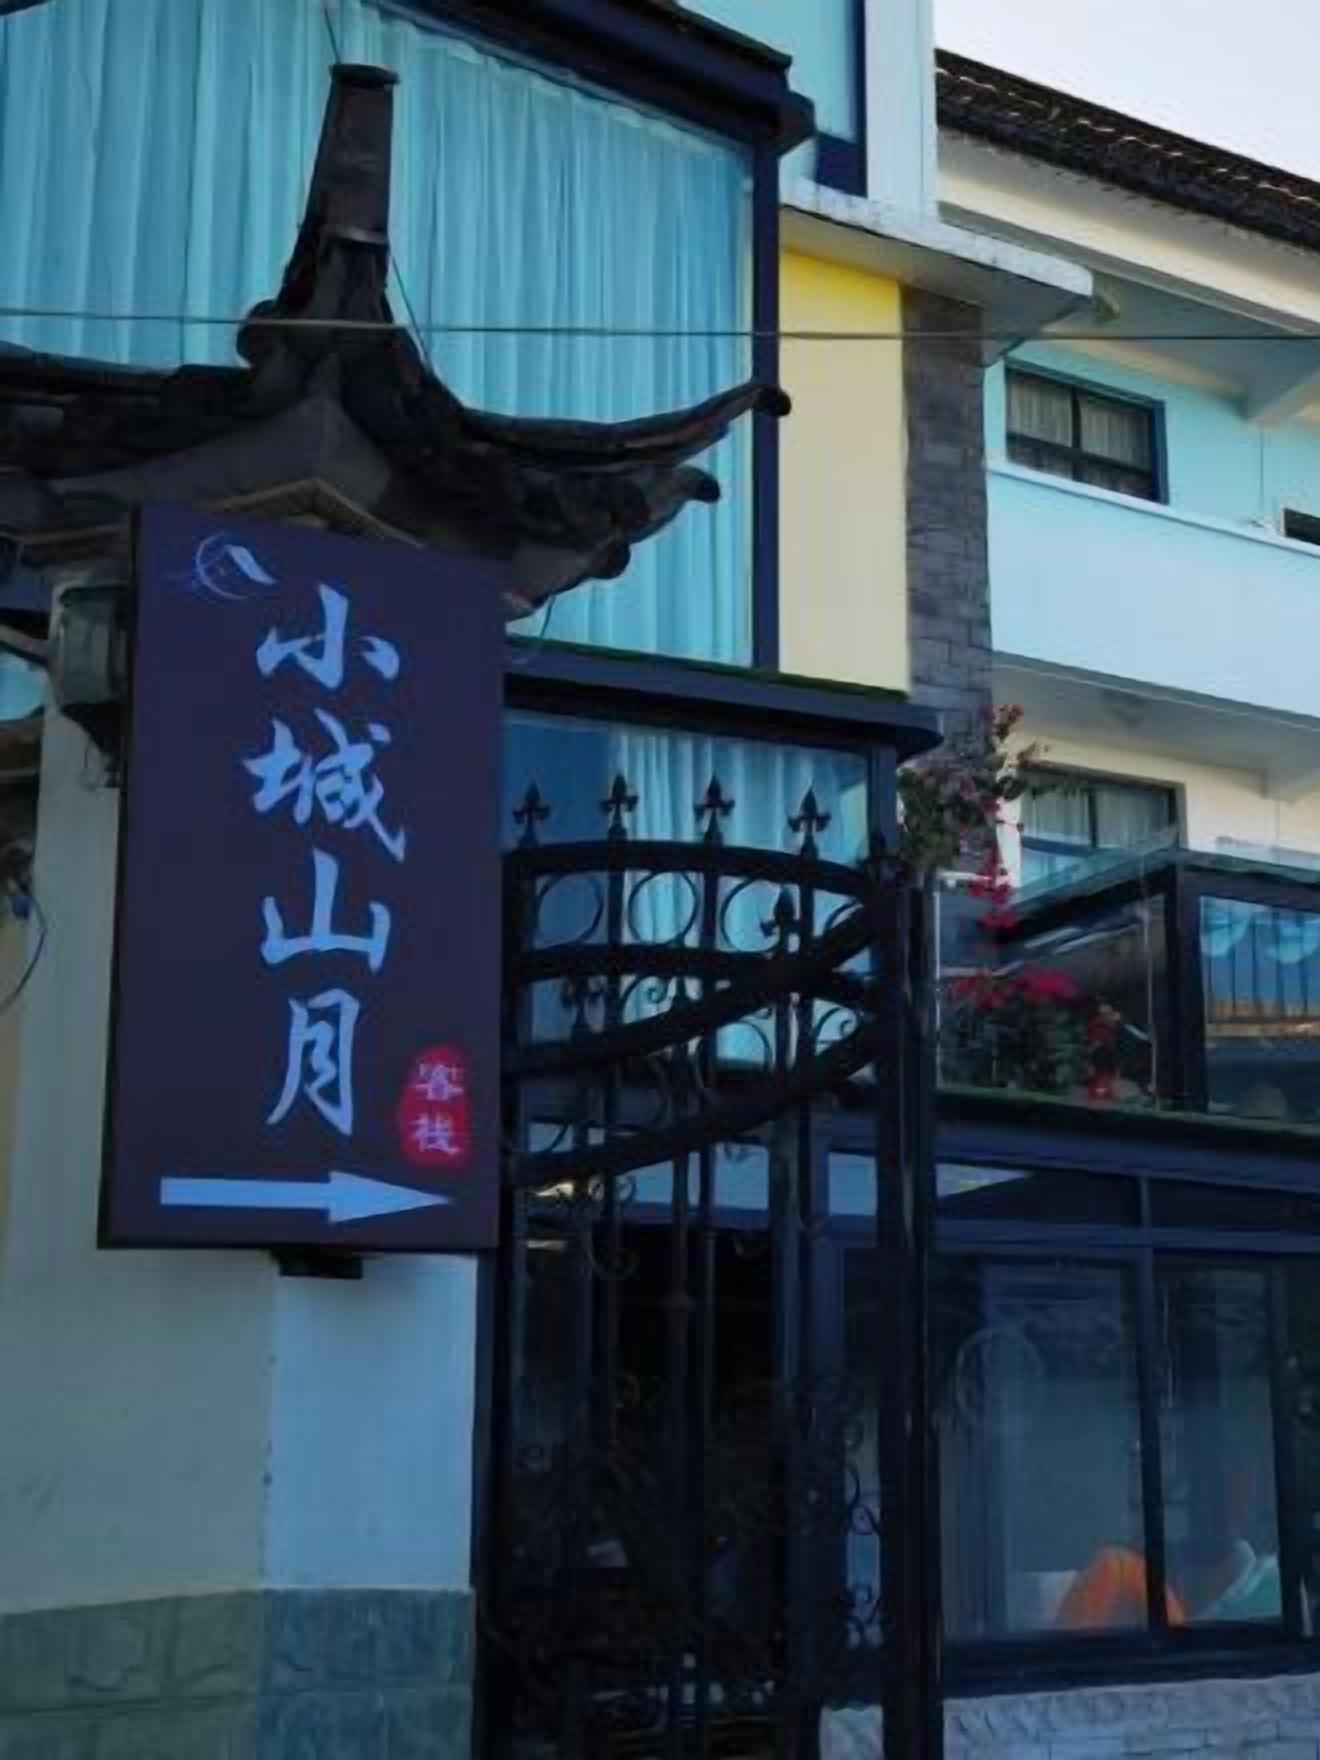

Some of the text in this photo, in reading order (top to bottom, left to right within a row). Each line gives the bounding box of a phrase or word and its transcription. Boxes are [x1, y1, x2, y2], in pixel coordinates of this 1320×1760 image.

[243, 582, 406, 1137] 小城山月
[411, 1062, 465, 1156] 客栈
